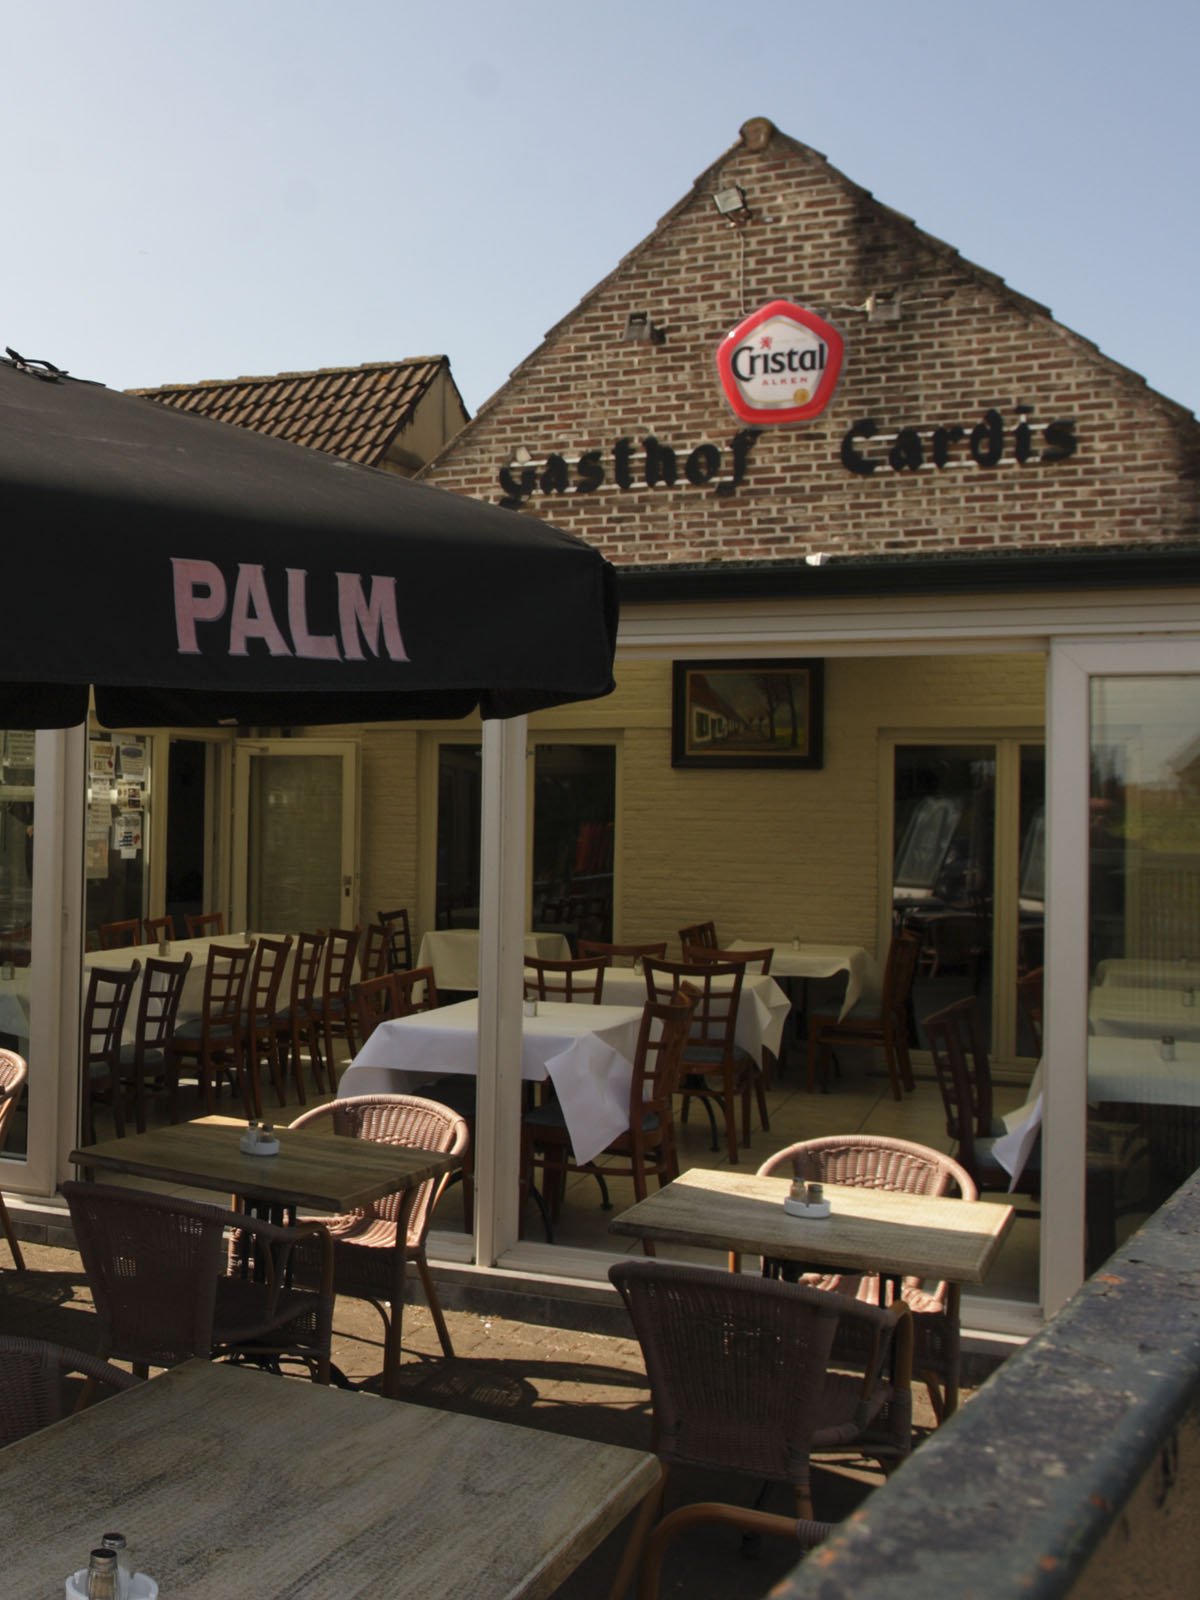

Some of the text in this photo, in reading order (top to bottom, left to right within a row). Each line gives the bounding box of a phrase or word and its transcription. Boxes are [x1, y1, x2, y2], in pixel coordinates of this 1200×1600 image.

[731, 343, 825, 382] Cristal
[762, 377, 808, 386] ALKEN
[840, 406, 1077, 475] Cardis
[170, 557, 411, 662] PALM
